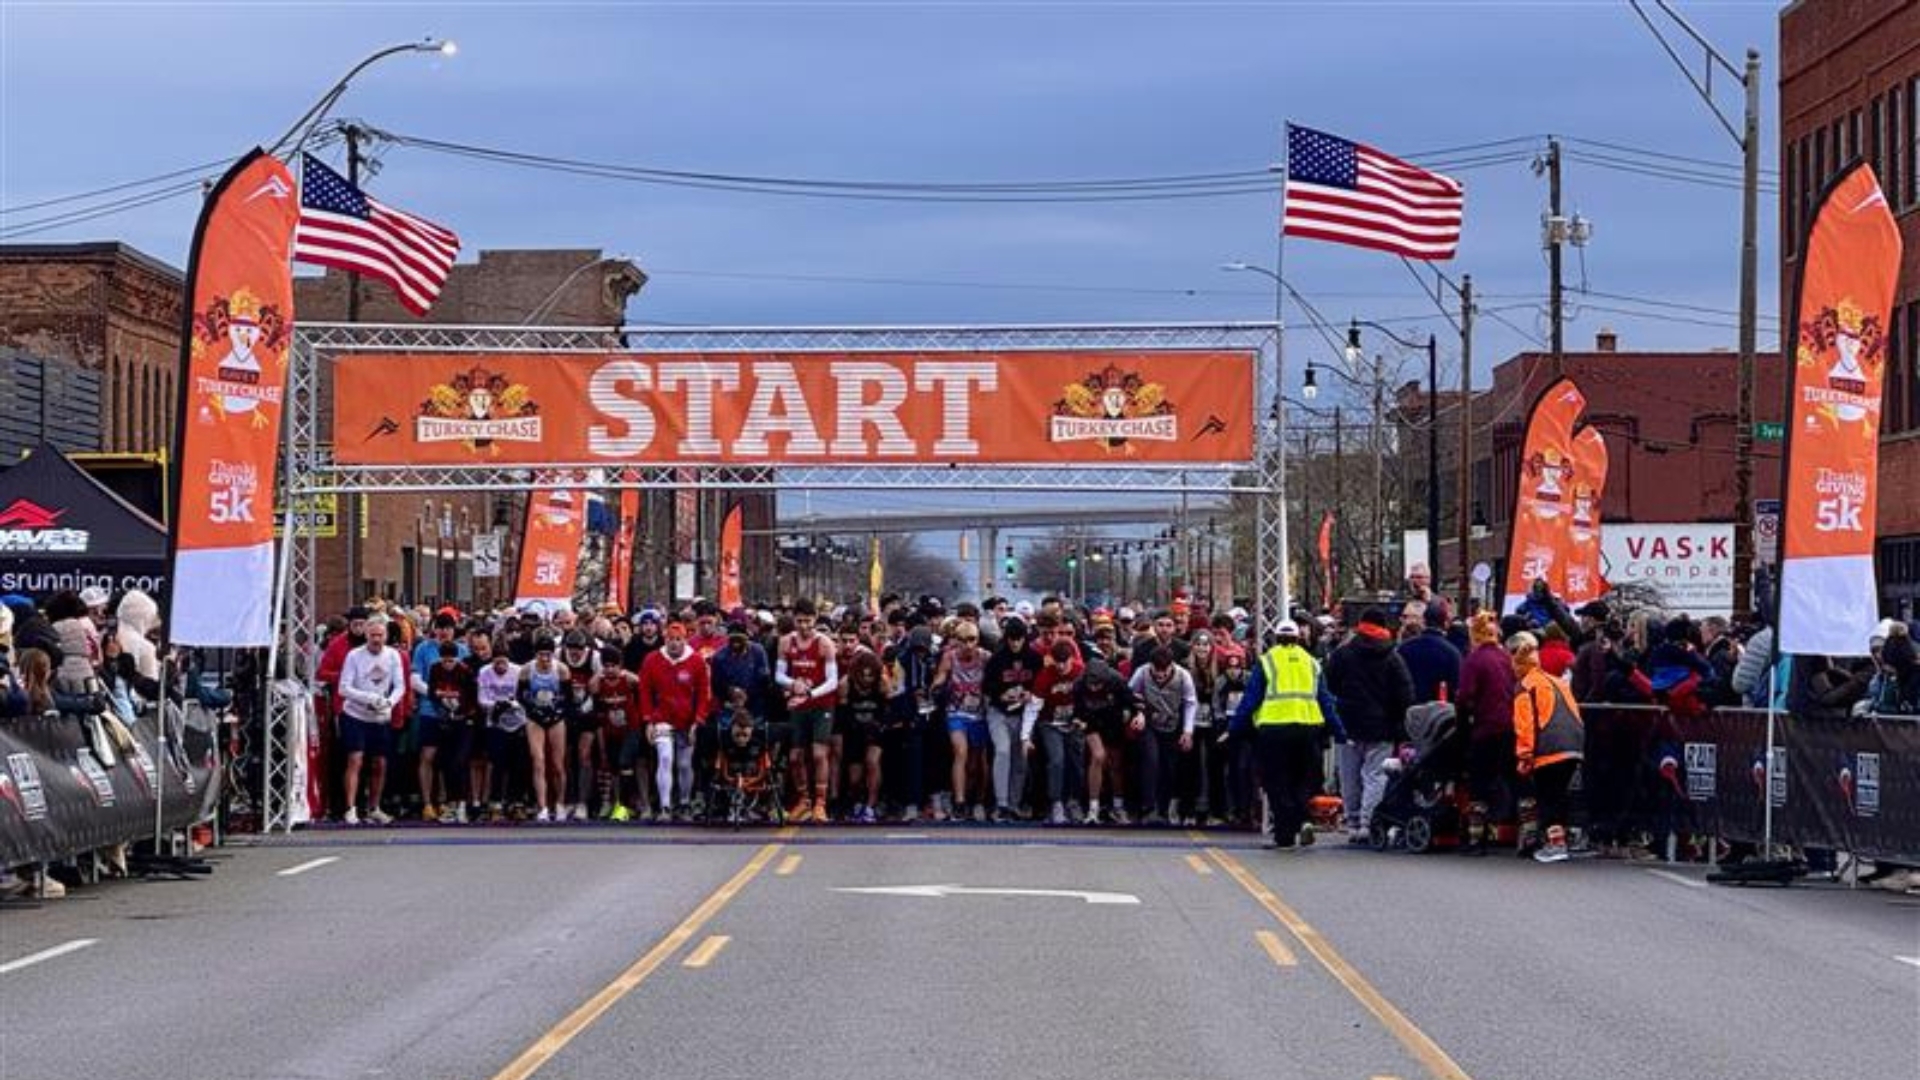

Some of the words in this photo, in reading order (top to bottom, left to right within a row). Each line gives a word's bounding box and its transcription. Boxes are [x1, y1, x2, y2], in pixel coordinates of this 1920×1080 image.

[588, 361, 998, 457] START
[421, 420, 483, 438] TURKEY
[486, 420, 539, 438] CHASE
[1055, 420, 1118, 438] TURKEY
[1120, 420, 1173, 438] CHASE
[209, 487, 254, 523] 5k
[1815, 496, 1863, 531] 5k
[535, 563, 561, 586] 5k
